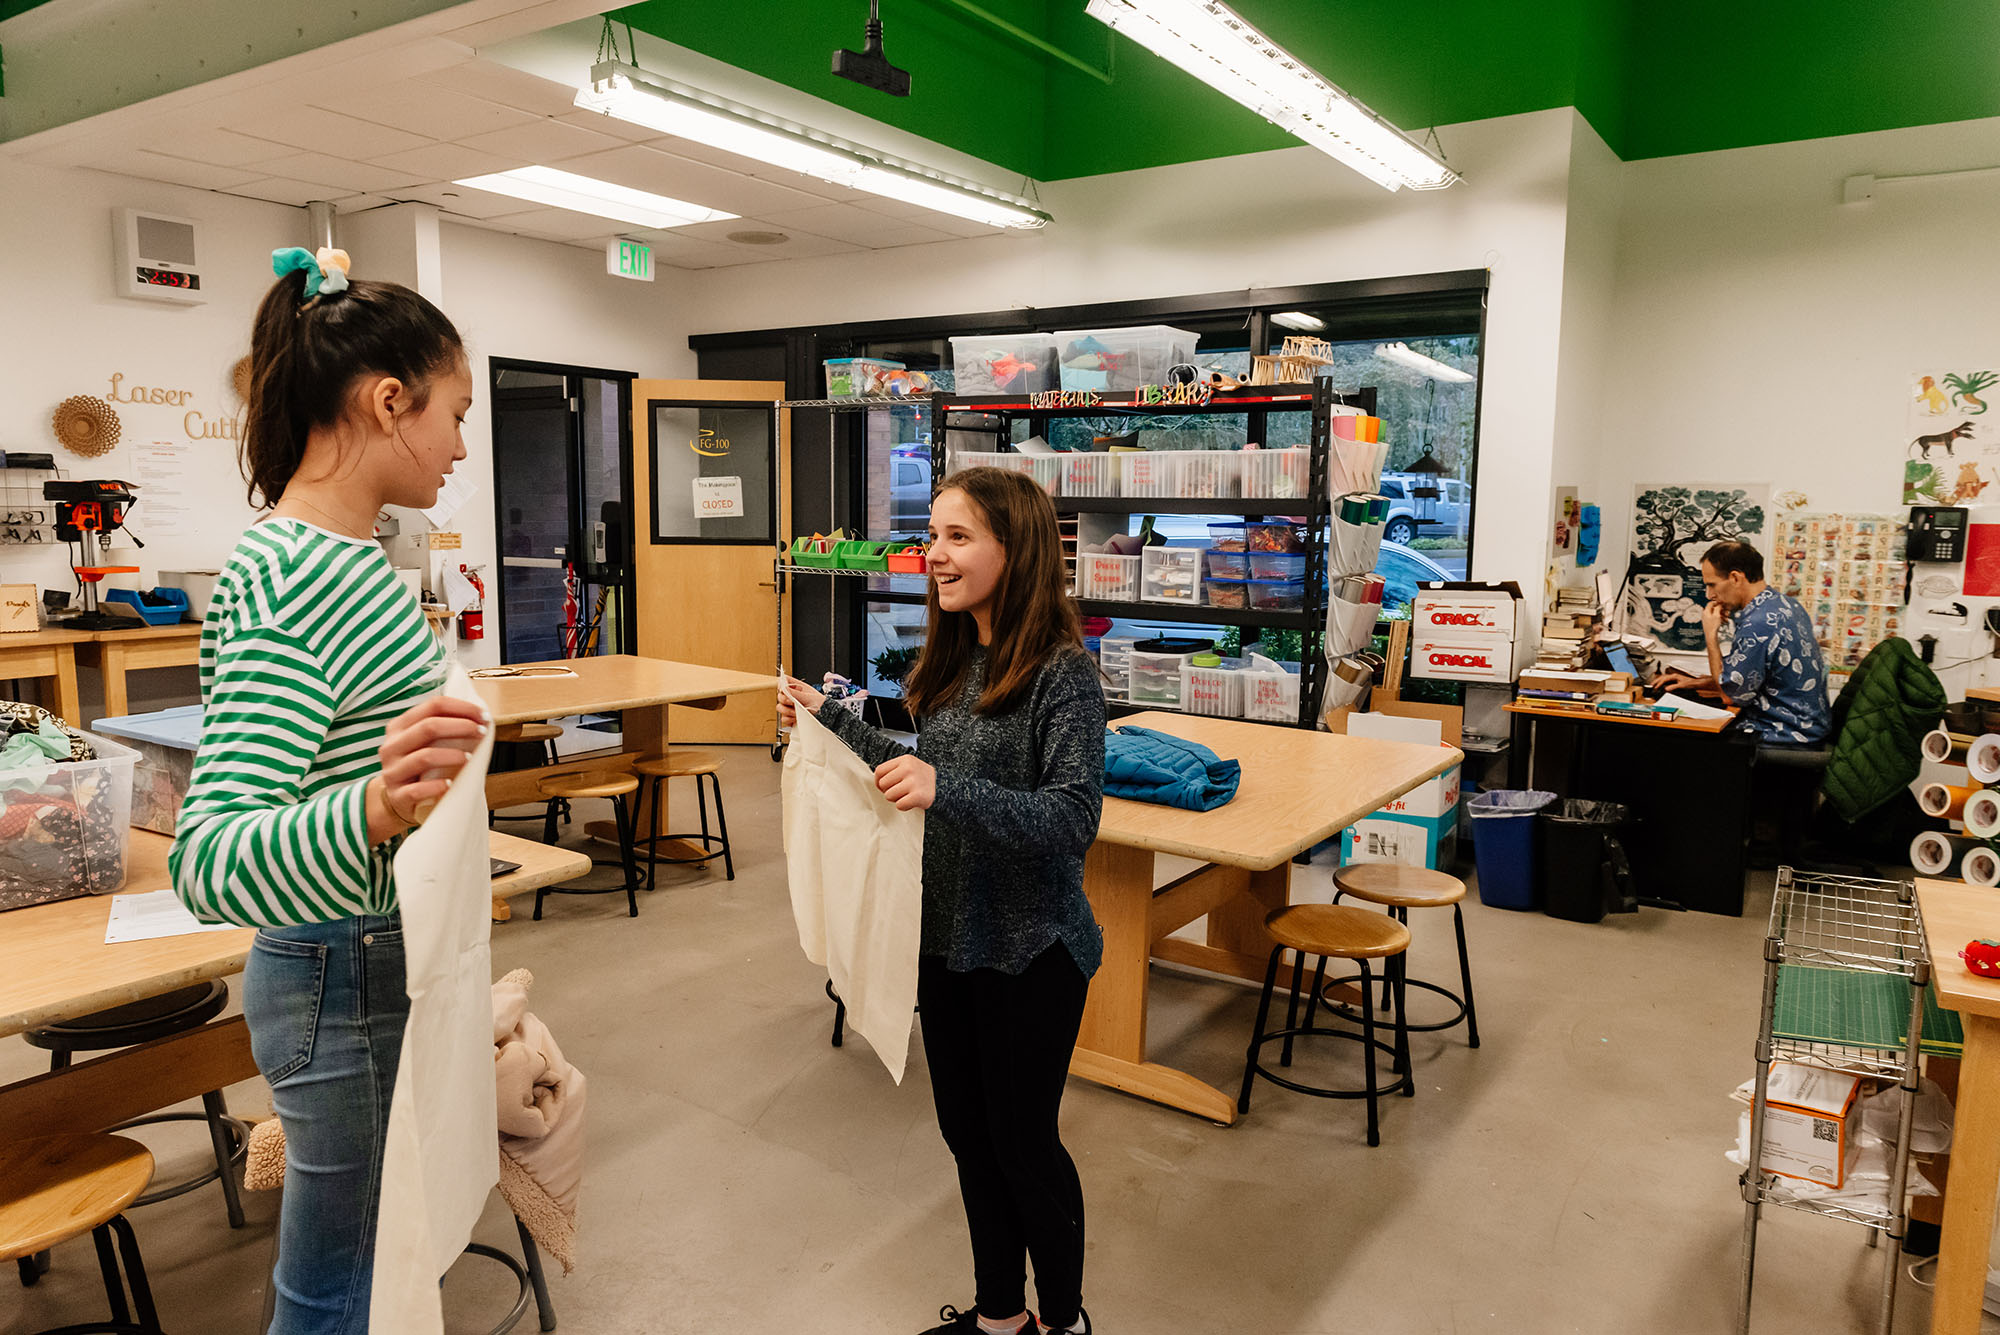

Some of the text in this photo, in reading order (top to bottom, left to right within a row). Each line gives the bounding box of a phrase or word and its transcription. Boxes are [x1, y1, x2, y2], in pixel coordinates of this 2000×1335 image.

[620, 241, 651, 278] EXIT
[150, 271, 190, 288] 2:53
[106, 372, 193, 406] Laser
[1029, 380, 1214, 409] MATERIALS LIBRARY
[184, 411, 247, 440] Cutt
[700, 438, 730, 449] FG-100
[702, 499, 734, 509] CLOSED
[1429, 653, 1493, 668] ORACAL
